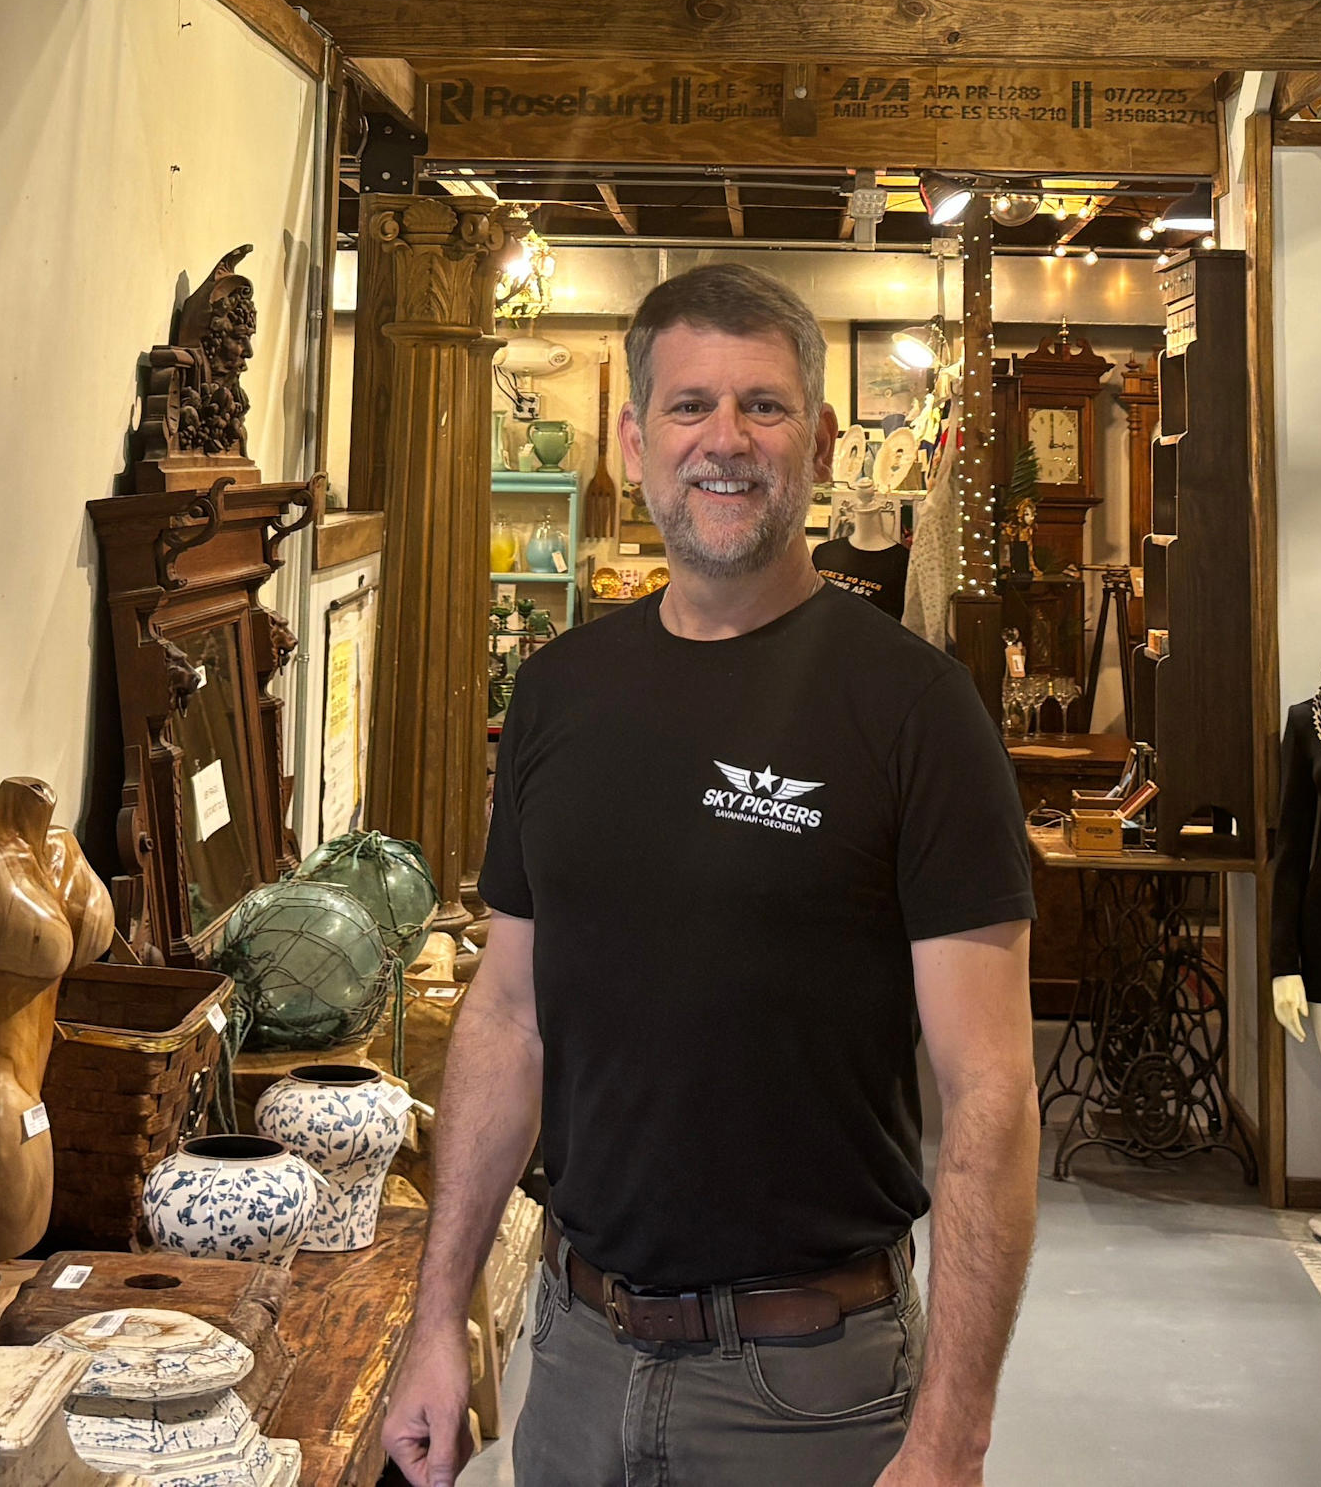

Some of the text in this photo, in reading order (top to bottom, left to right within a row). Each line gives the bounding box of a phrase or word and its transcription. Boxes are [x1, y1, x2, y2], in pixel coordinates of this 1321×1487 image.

[484, 77, 664, 123] Roseburg
[832, 77, 910, 101] APA
[923, 85, 960, 100] APA
[834, 102, 866, 118] Mill
[988, 106, 1067, 121] ESR-1210
[702, 788, 822, 828] SKY PICKERS
[715, 809, 802, 834] SAVANNAH GEORGIA
